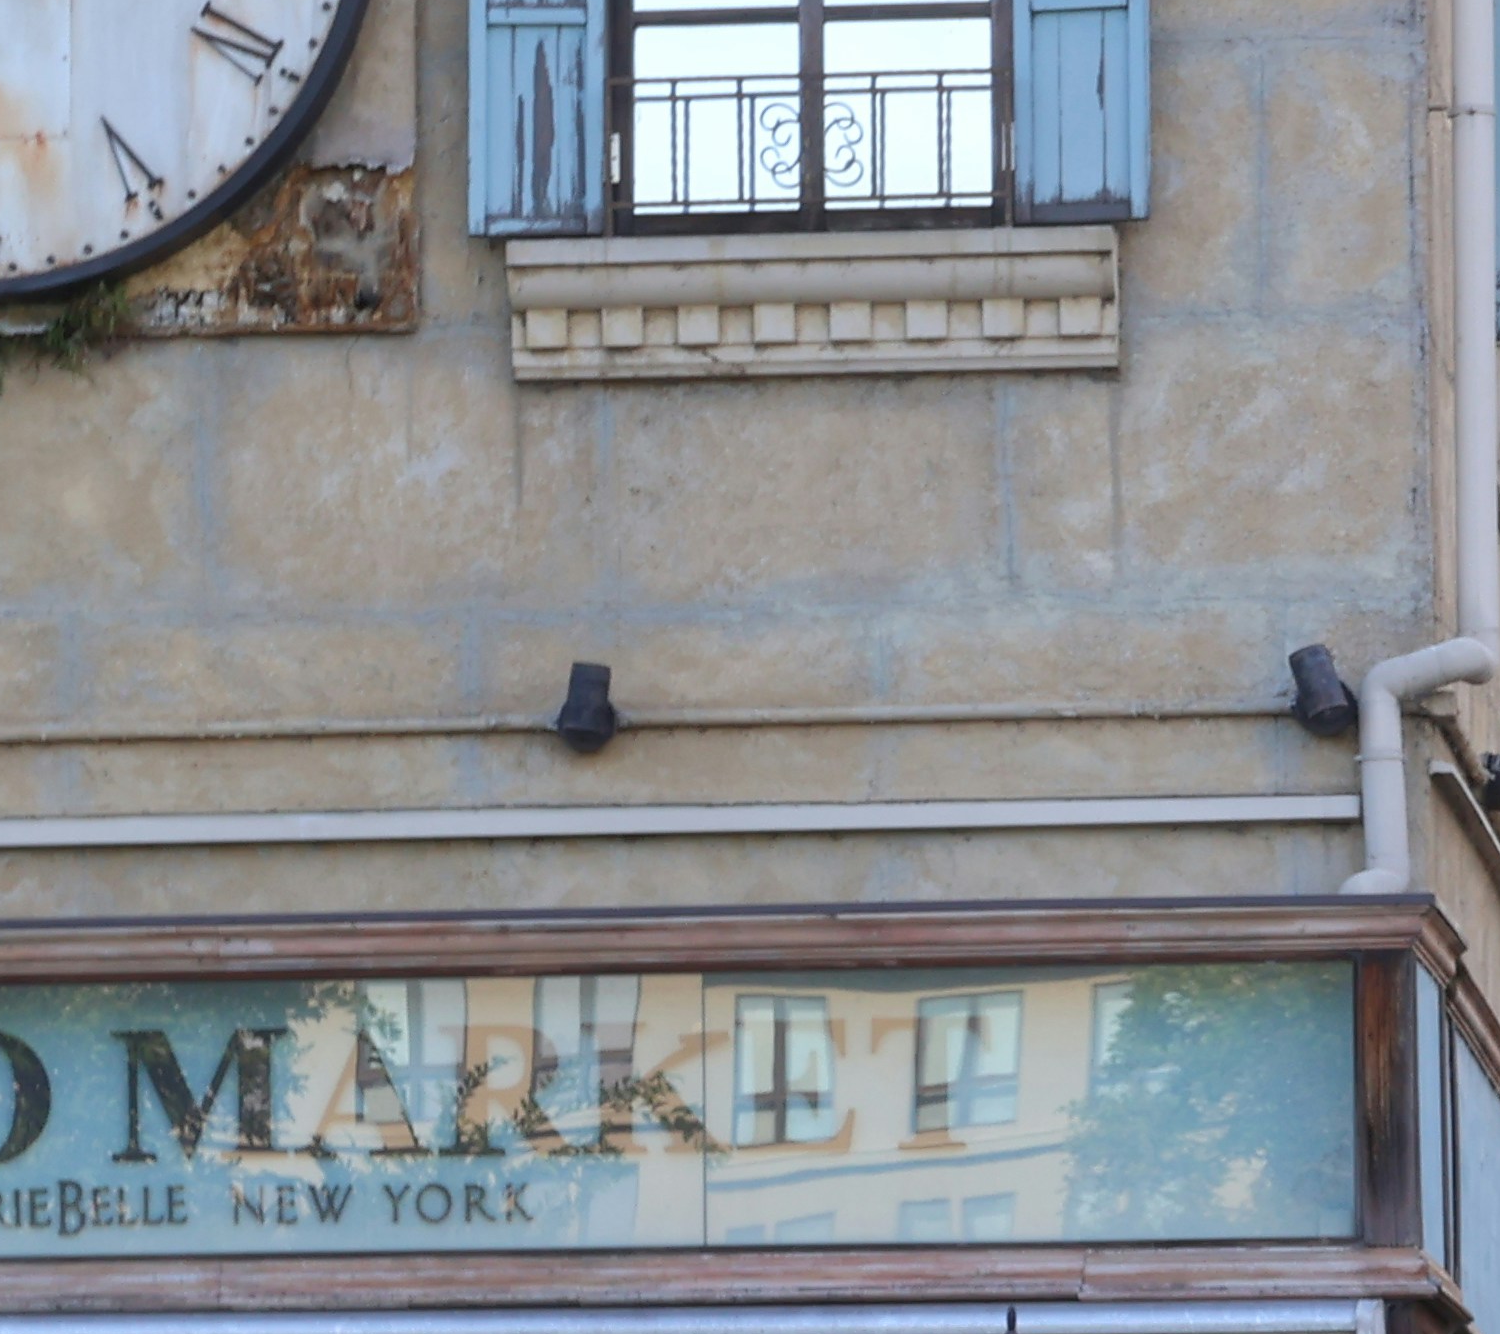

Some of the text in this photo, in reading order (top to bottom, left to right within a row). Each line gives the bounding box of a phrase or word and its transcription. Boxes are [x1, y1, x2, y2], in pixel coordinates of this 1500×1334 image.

[111, 1013, 992, 1164] MARKET
[232, 1184, 356, 1228] NEW
[381, 1181, 535, 1227] YORK
